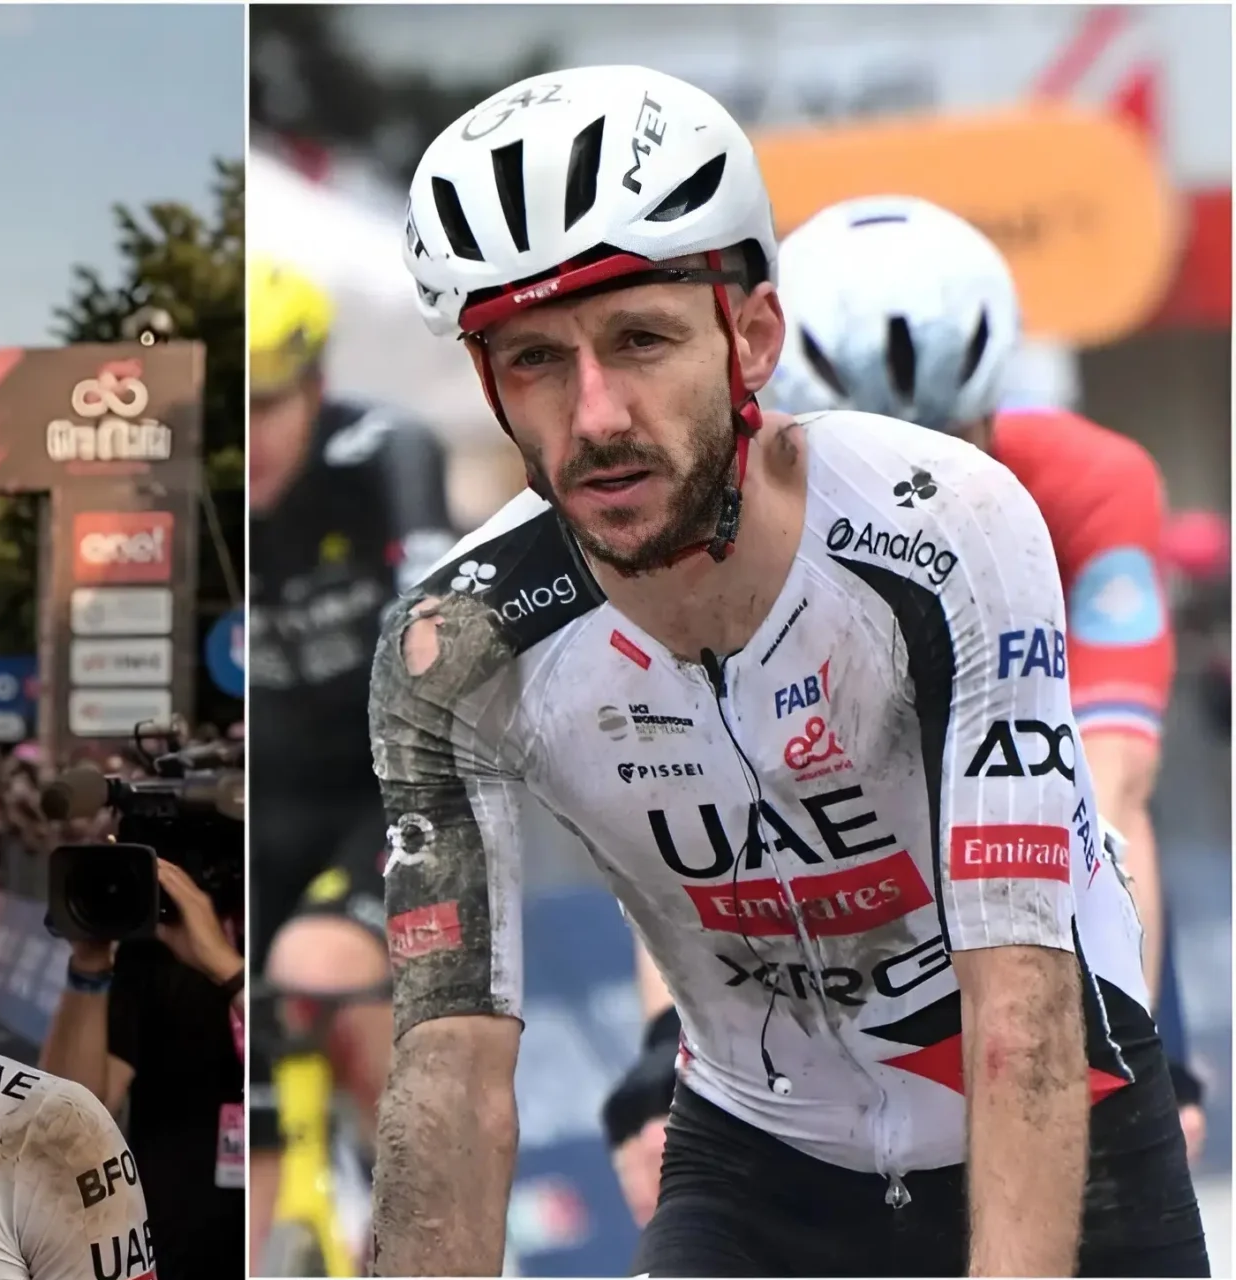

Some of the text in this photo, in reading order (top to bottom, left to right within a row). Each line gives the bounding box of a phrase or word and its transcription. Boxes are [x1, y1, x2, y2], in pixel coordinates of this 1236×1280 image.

[623, 91, 666, 194] MET
[79, 525, 167, 565] enel
[854, 522, 958, 584] Analog
[637, 763, 704, 779] PISSEI
[648, 785, 897, 879] UAE
